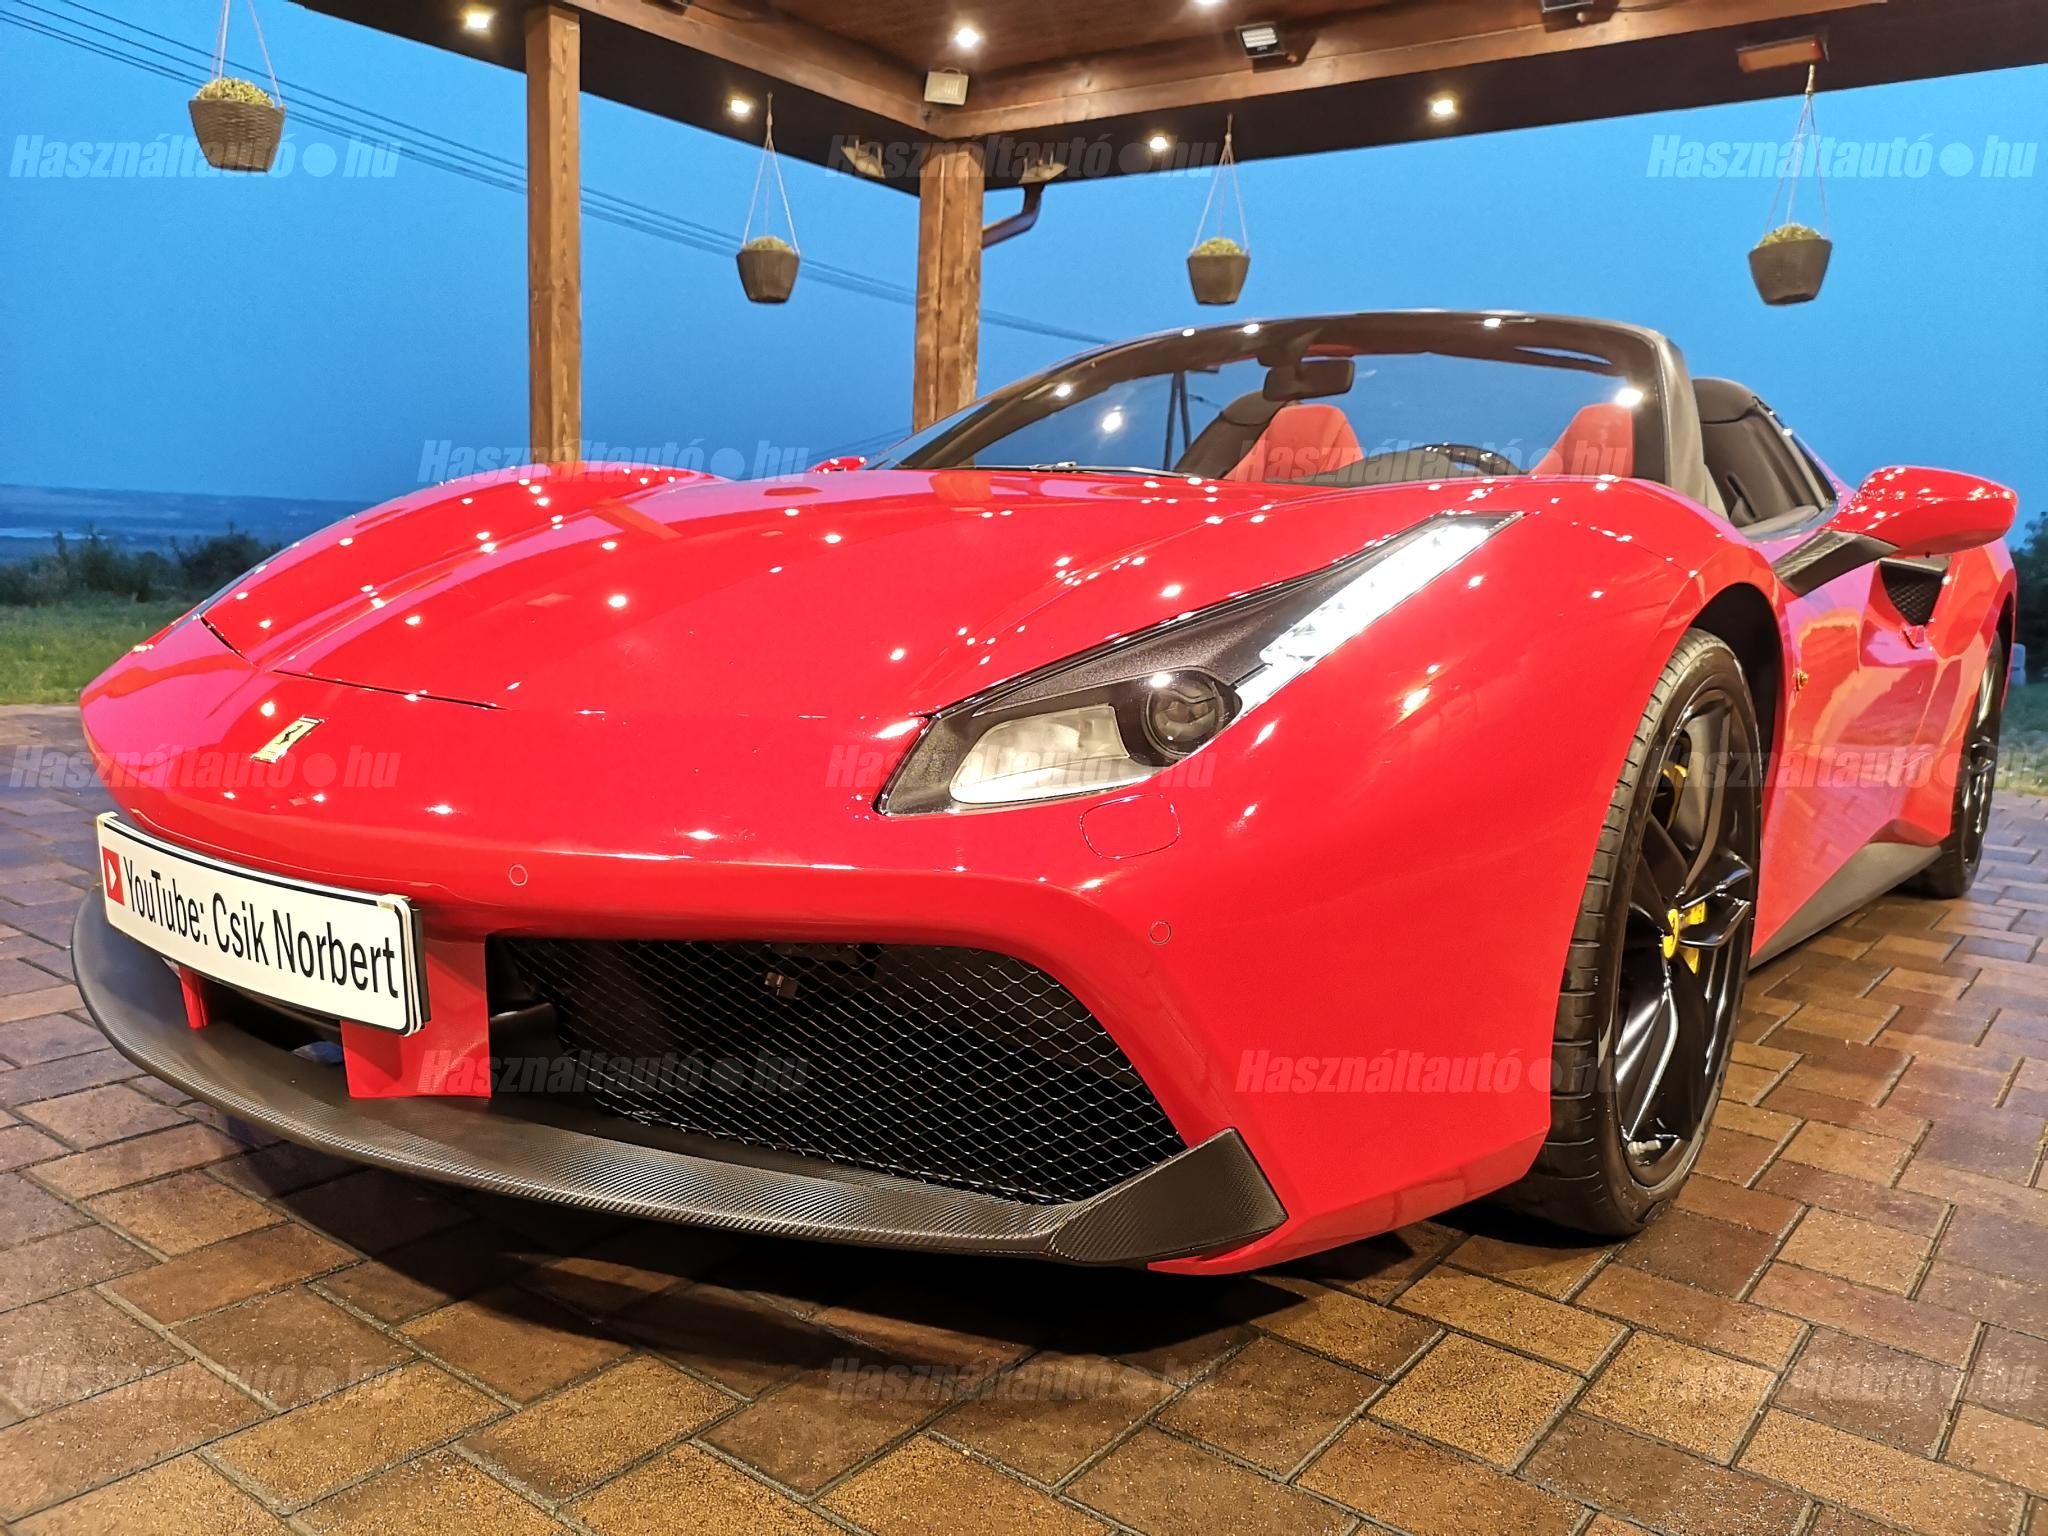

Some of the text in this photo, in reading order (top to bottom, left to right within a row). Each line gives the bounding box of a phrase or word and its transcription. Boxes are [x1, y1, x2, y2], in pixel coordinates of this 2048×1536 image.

[123, 856, 399, 999] YouTube: Csik Norbert
